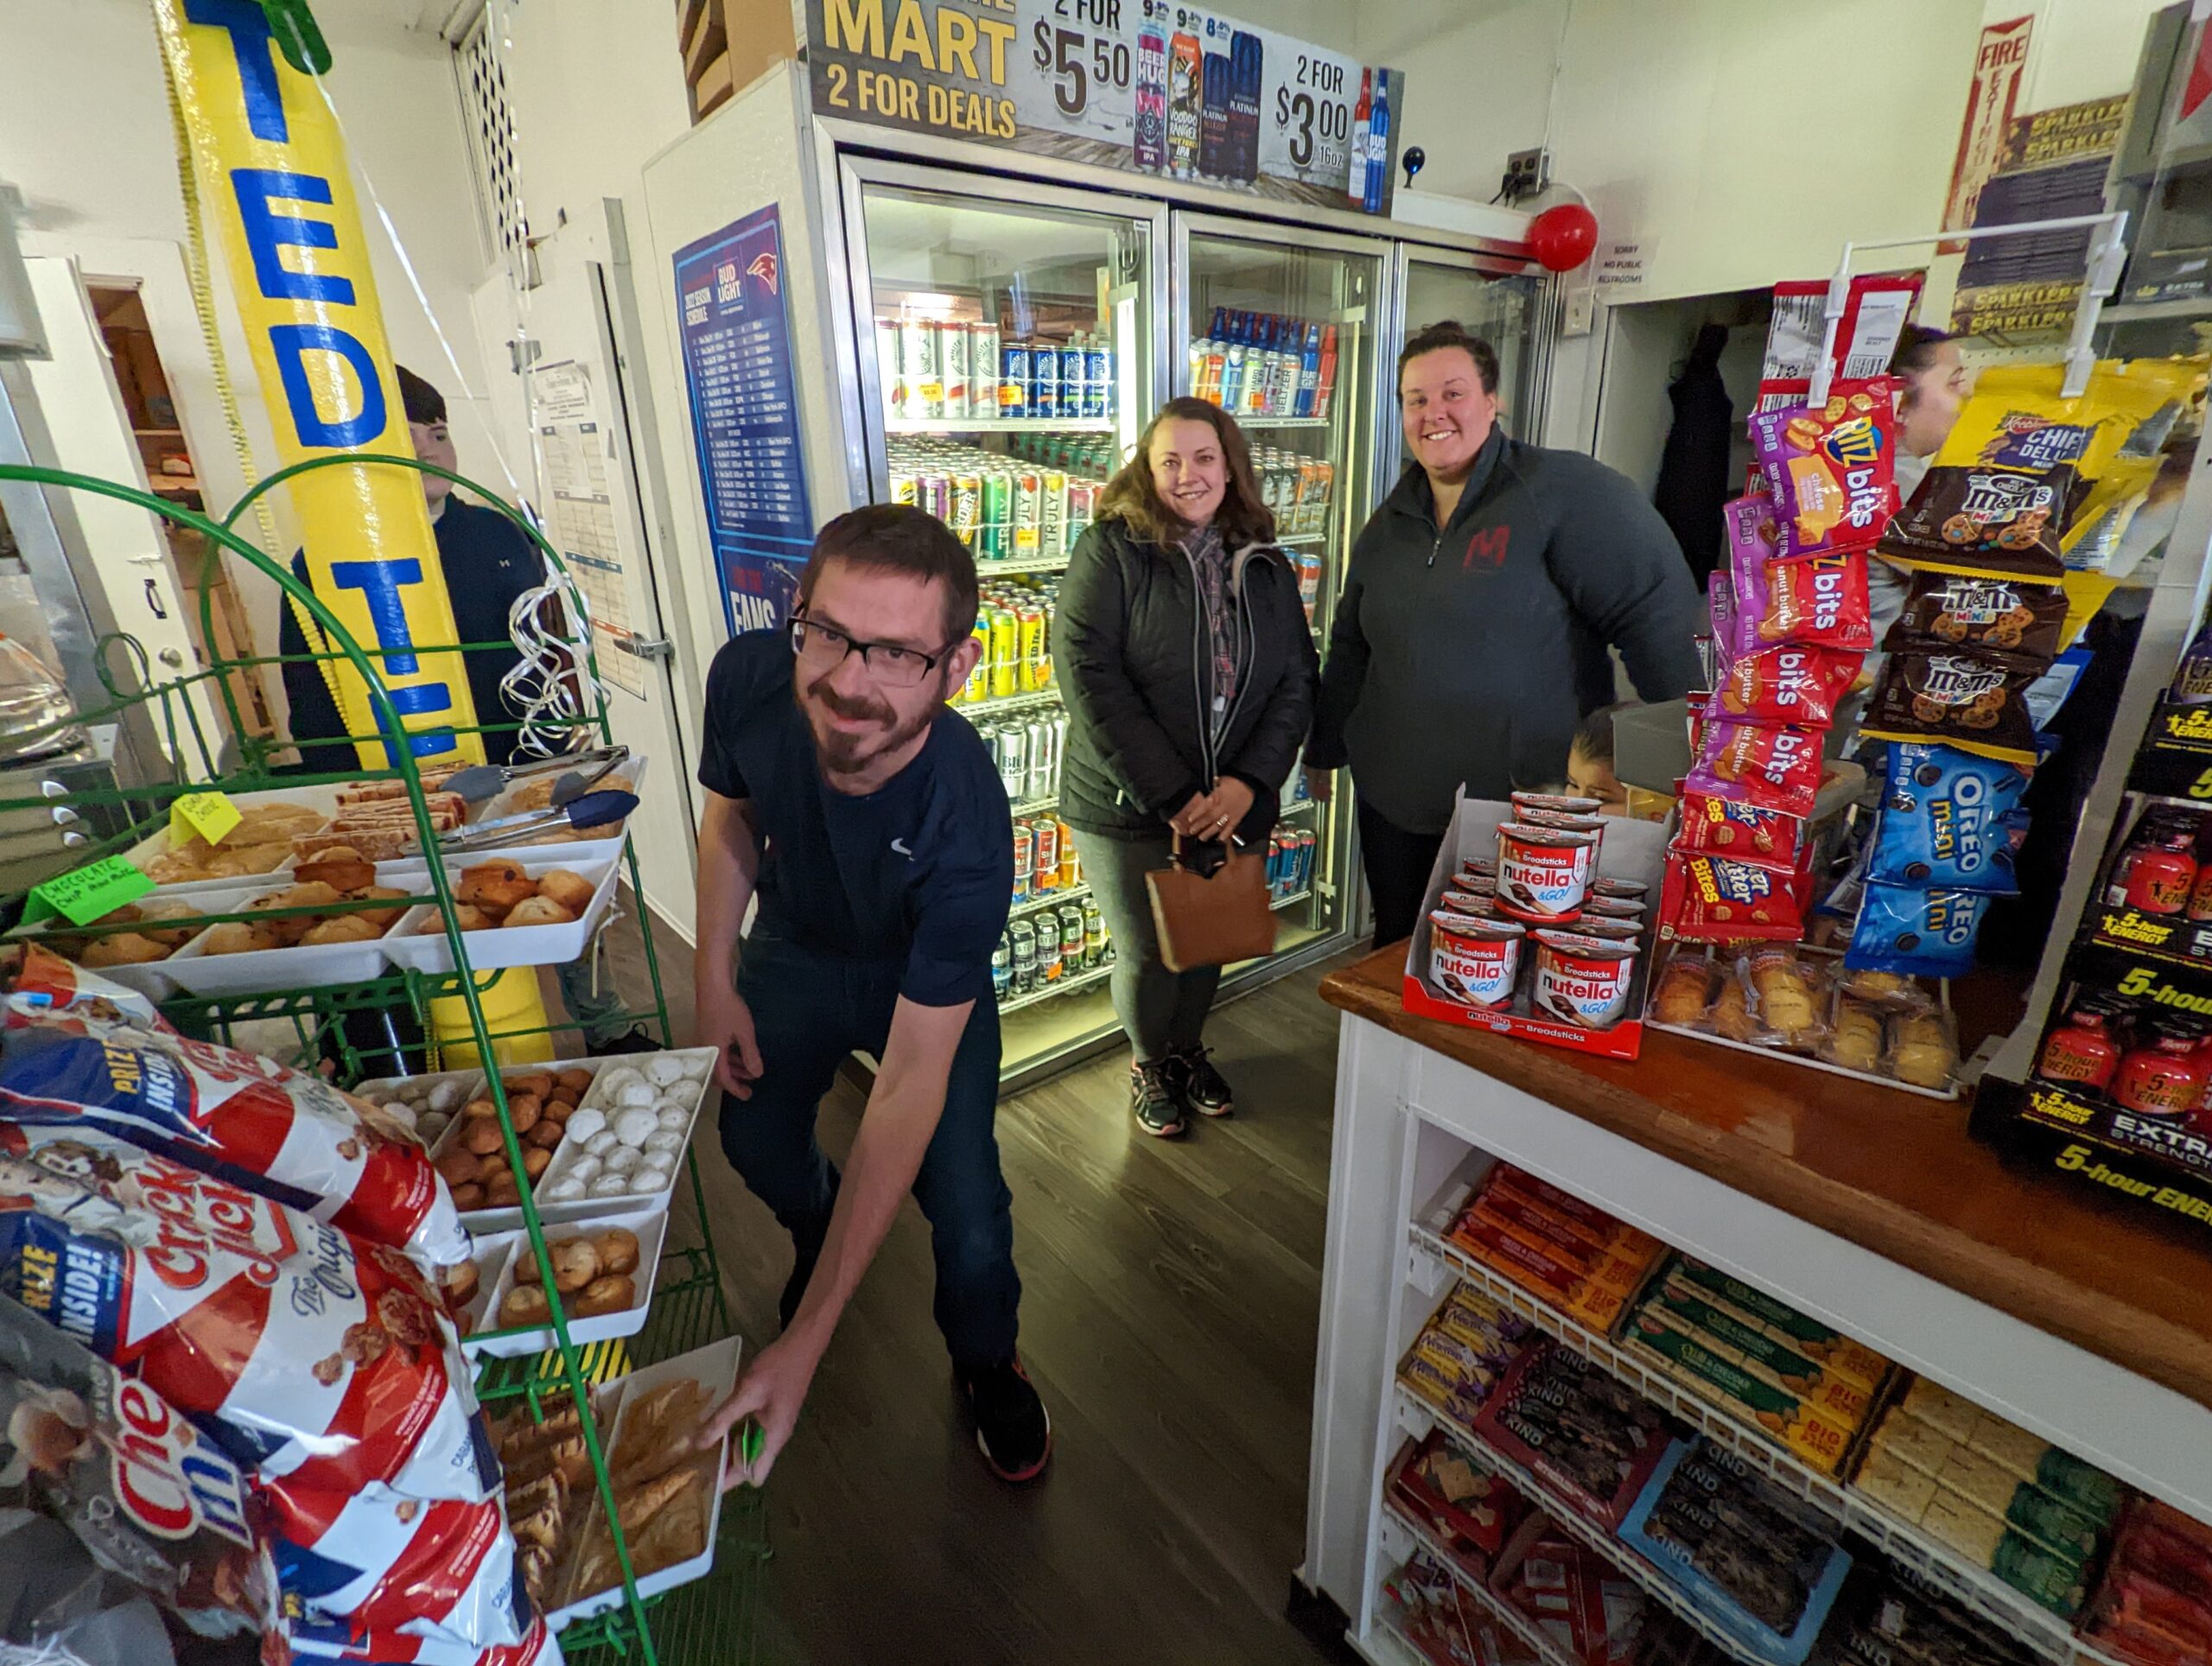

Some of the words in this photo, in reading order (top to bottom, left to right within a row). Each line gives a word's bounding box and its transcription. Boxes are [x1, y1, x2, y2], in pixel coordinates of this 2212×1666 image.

[823, 0, 1016, 86] MART
[1979, 35, 2027, 72] FIRE
[1297, 55, 1307, 85] 2
[1312, 60, 1344, 94] FOR
[827, 63, 849, 108] 2
[857, 68, 920, 122] FOR
[928, 84, 1016, 139] DEALS
[718, 264, 735, 285] BUD
[718, 280, 741, 303] LIGHT
[2018, 444, 2069, 461] DELU
[2026, 429, 2083, 449] CHIP
[1846, 467, 1883, 528] bits
[1045, 495, 1058, 543] TRULY
[1815, 573, 1843, 630] bits
[1777, 652, 1806, 705] bits
[1764, 734, 1804, 785] bits
[1932, 799, 1956, 860] mini
[1955, 775, 1984, 873] OREO
[1504, 864, 1570, 887] nutella
[1522, 853, 1568, 866] Breadsticks
[1691, 857, 1719, 903] Bites
[1948, 895, 1977, 944] REO
[2111, 925, 2168, 944] ENERGY
[2120, 912, 2173, 936] 5-hour
[1436, 954, 1501, 979] nutella
[1454, 944, 1497, 959] Breadsticks
[1543, 974, 1613, 1000] nutella
[1564, 965, 1611, 979] Breadsticks
[2117, 968, 2212, 1015] 5-hou
[1526, 1024, 1586, 1042] Breadsticks
[2056, 1144, 2157, 1198] 5-hour
[291, 1275, 327, 1317] The
[1554, 1348, 1590, 1373] KIND
[1527, 1388, 1564, 1408] KIND
[1506, 1417, 1543, 1447] KIND
[119, 1385, 194, 1532] Che
